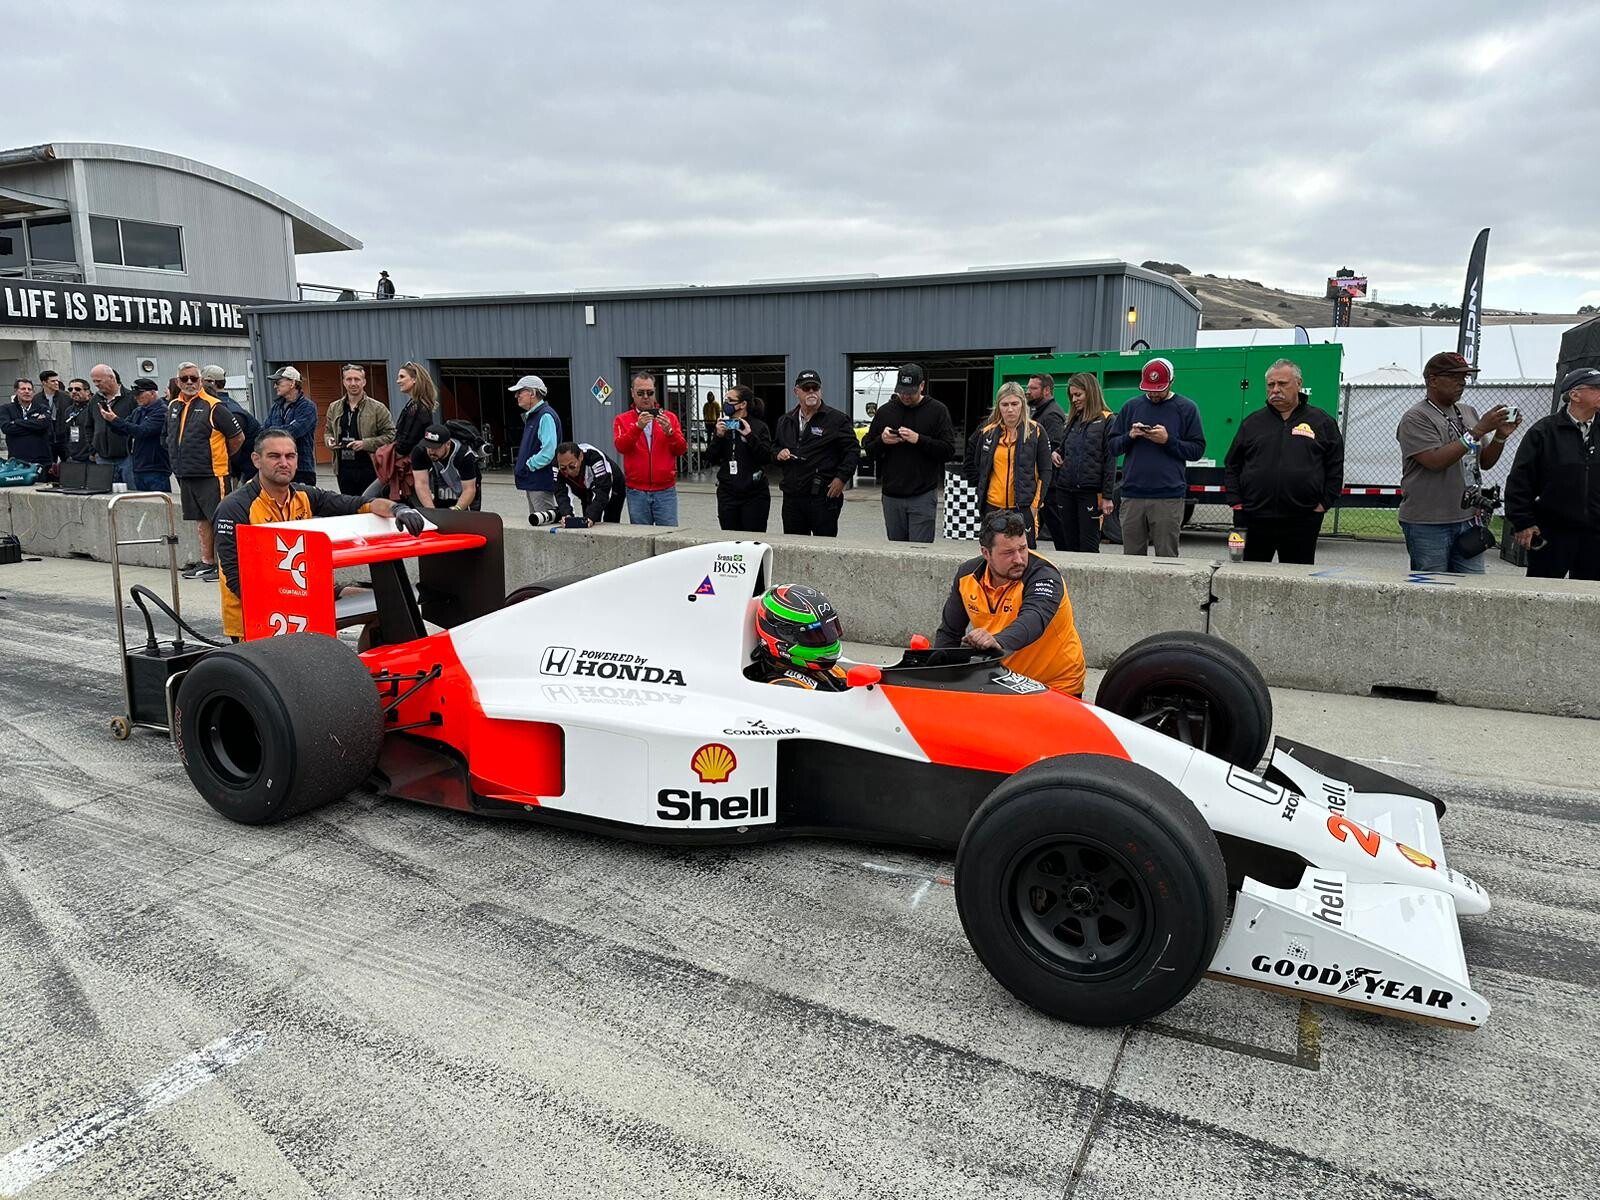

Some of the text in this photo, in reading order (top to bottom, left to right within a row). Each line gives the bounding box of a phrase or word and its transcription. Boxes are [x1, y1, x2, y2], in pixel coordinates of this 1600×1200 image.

[4, 287, 244, 329] LIFE IS BETTER AT THE
[713, 561, 747, 574] BOSS
[717, 553, 733, 561] Senna
[269, 612, 308, 636] 27
[579, 650, 648, 665] POWERED by
[573, 660, 687, 686] HONDA
[723, 728, 800, 736] COURTAULDS
[656, 787, 769, 821] Shell
[1322, 783, 1346, 818] hell
[1312, 878, 1344, 926] hell
